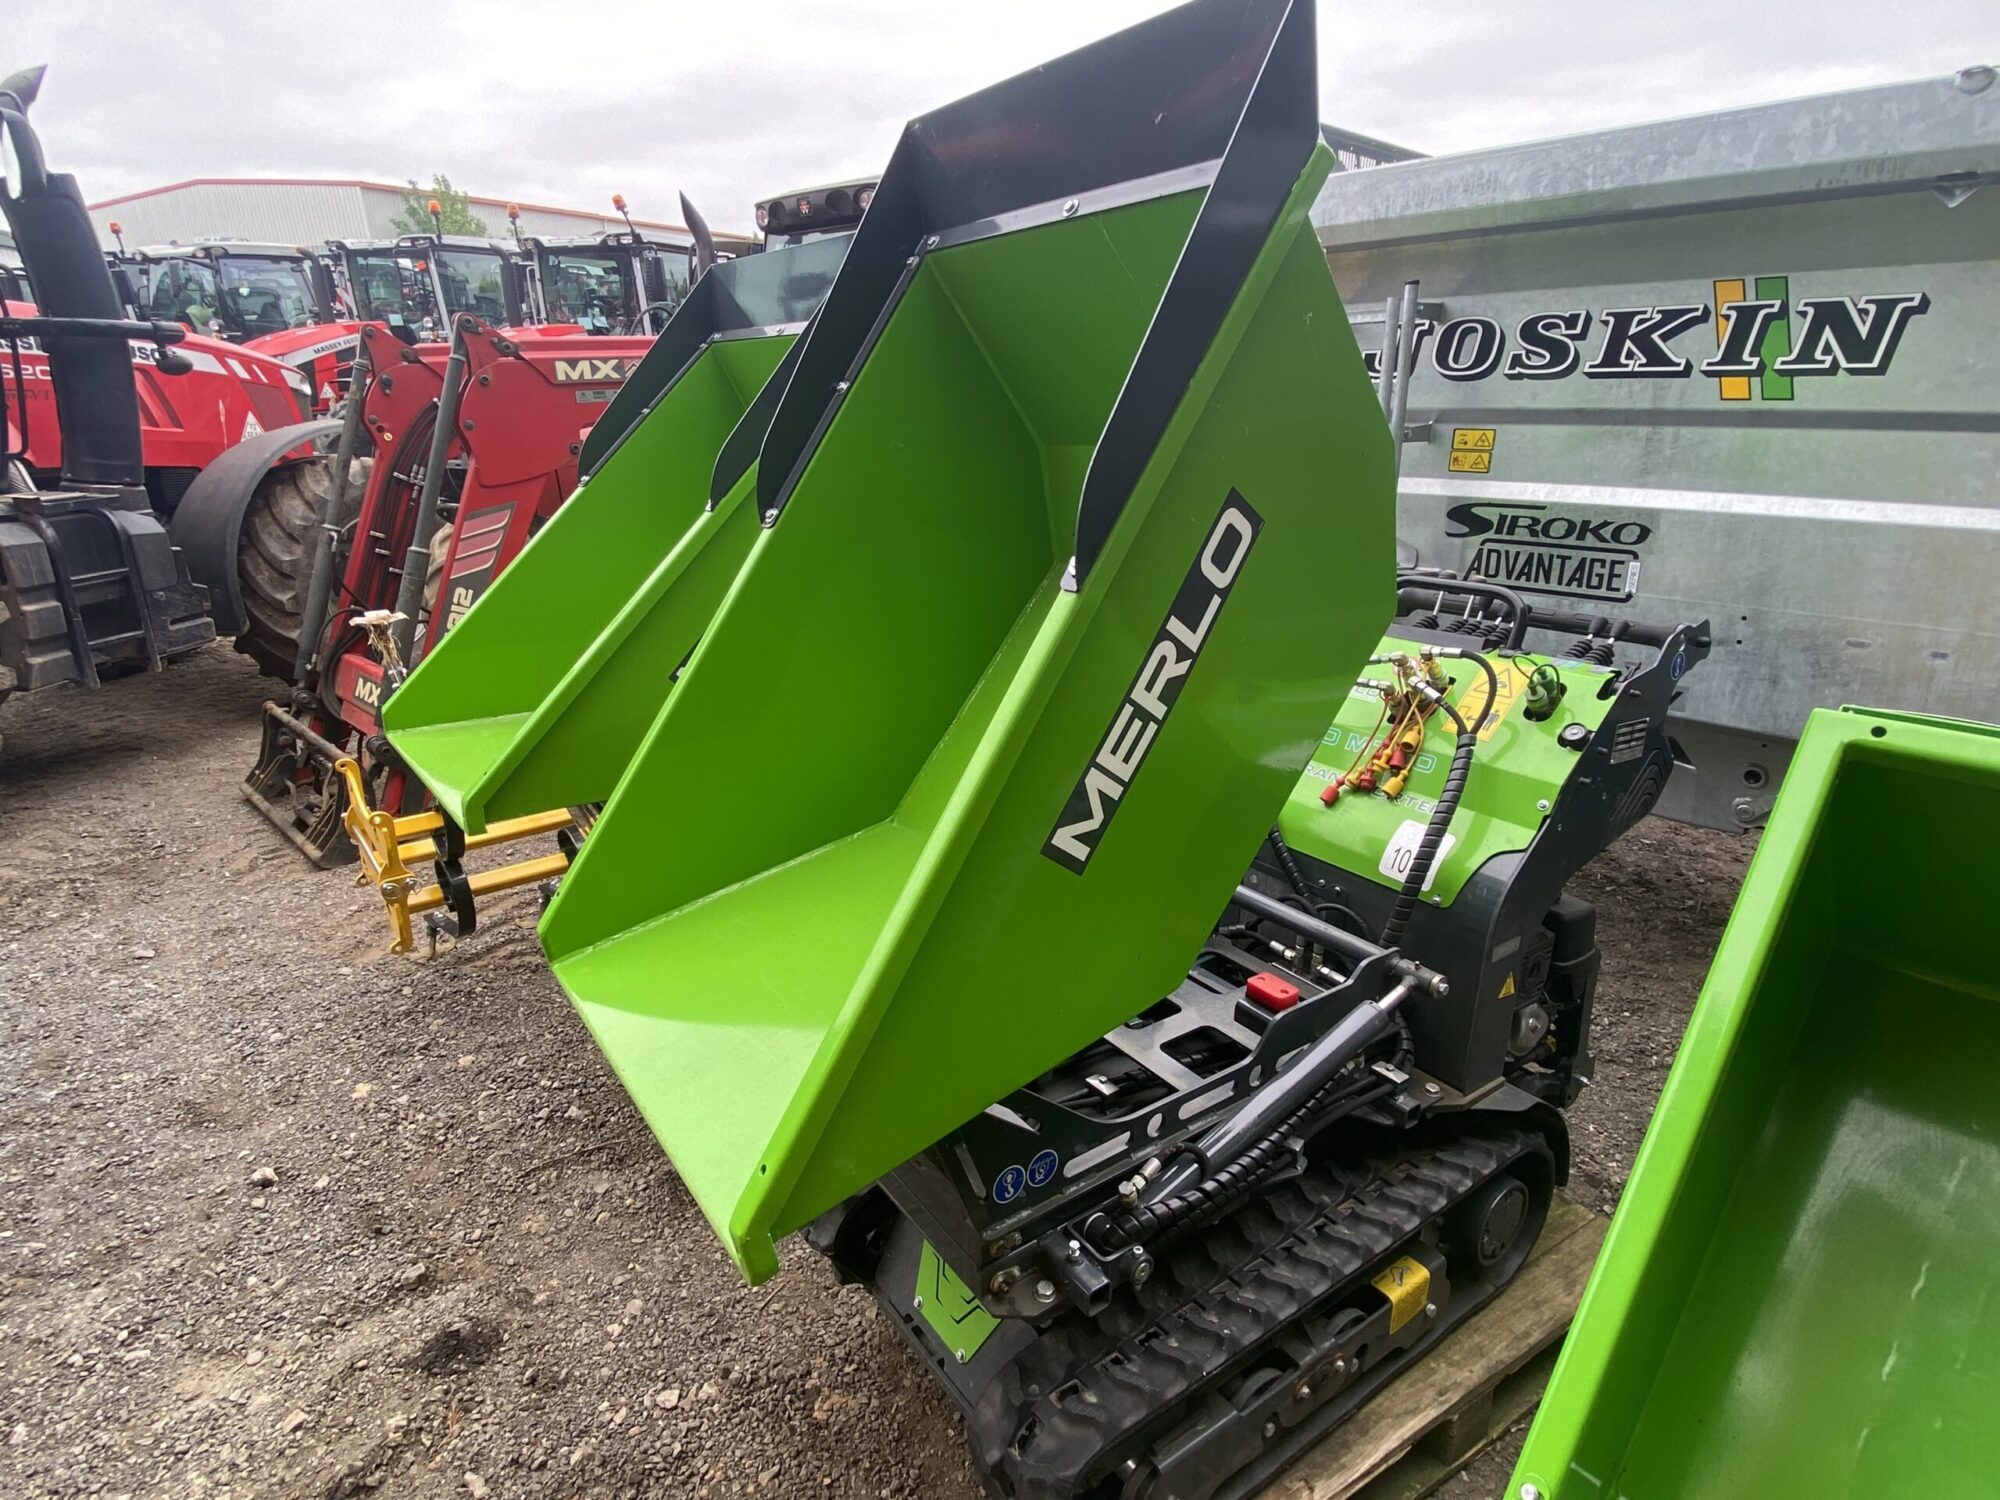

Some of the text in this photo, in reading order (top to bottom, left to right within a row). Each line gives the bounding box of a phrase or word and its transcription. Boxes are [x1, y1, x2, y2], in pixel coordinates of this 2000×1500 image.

[313, 341, 342, 356] MASSEY
[555, 359, 621, 380] MX
[1445, 502, 1654, 546] SIROKO
[1463, 547, 1626, 593] ADVANTAGE
[355, 676, 382, 707] MX
[1050, 507, 1252, 862] MERLO
